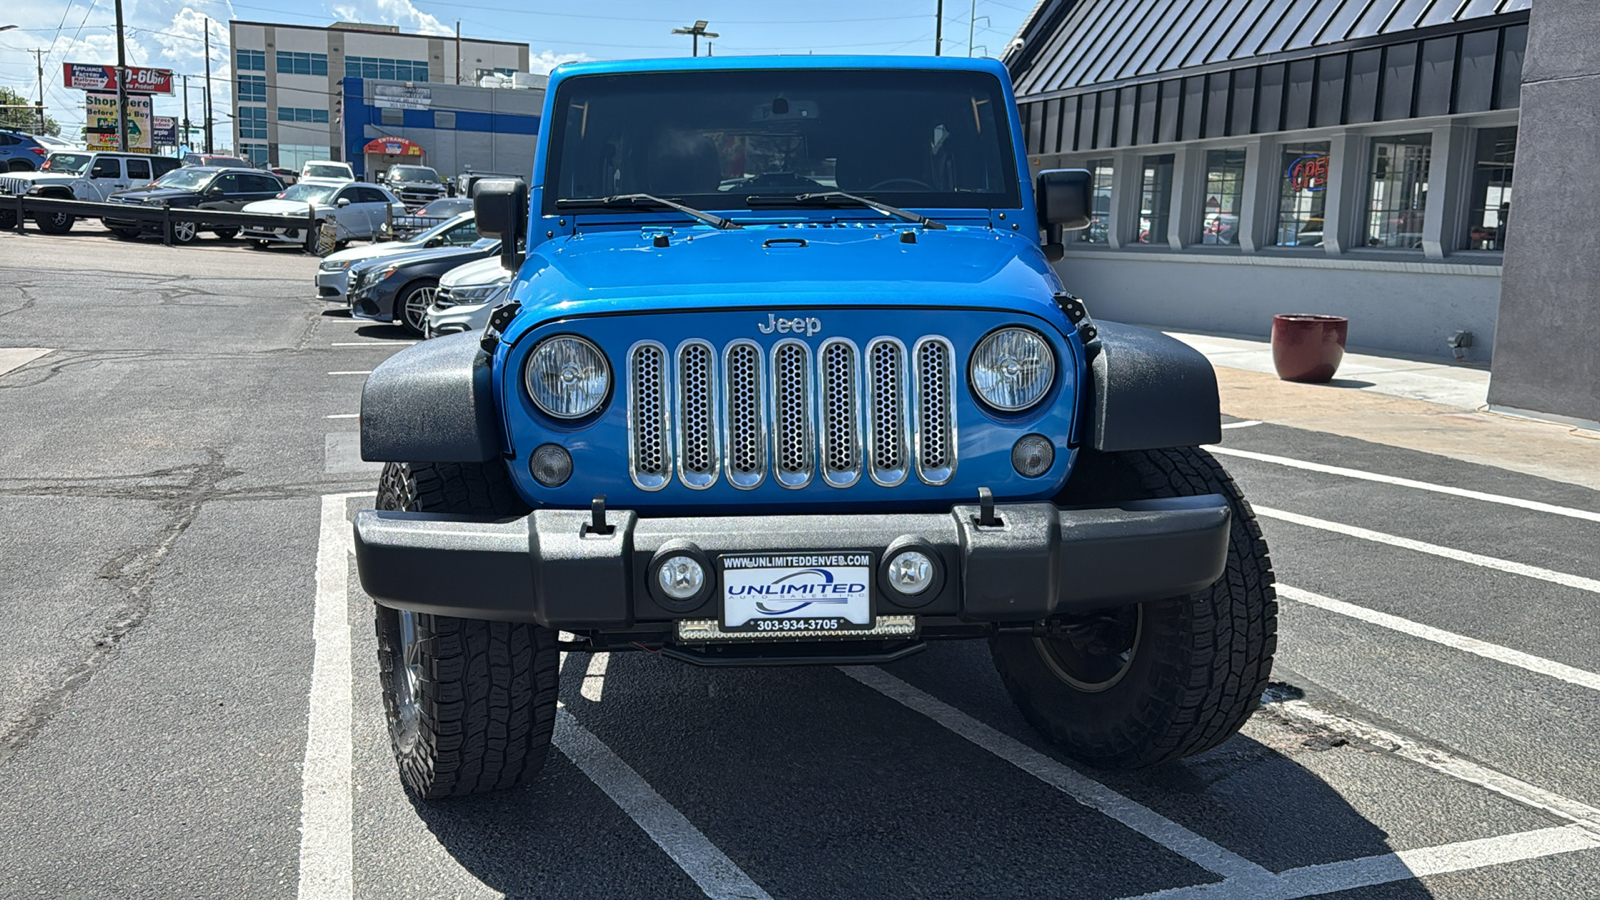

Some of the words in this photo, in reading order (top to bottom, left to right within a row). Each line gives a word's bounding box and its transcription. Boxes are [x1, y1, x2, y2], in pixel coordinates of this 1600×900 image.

[86, 95, 117, 107] Shop
[87, 108, 114, 116] Before
[134, 110, 149, 119] Buy
[377, 137, 409, 145] ENTRANCE
[757, 313, 822, 337] Jeep
[728, 583, 865, 595] UNLIMITED
[757, 619, 838, 631] 303-934-3705
